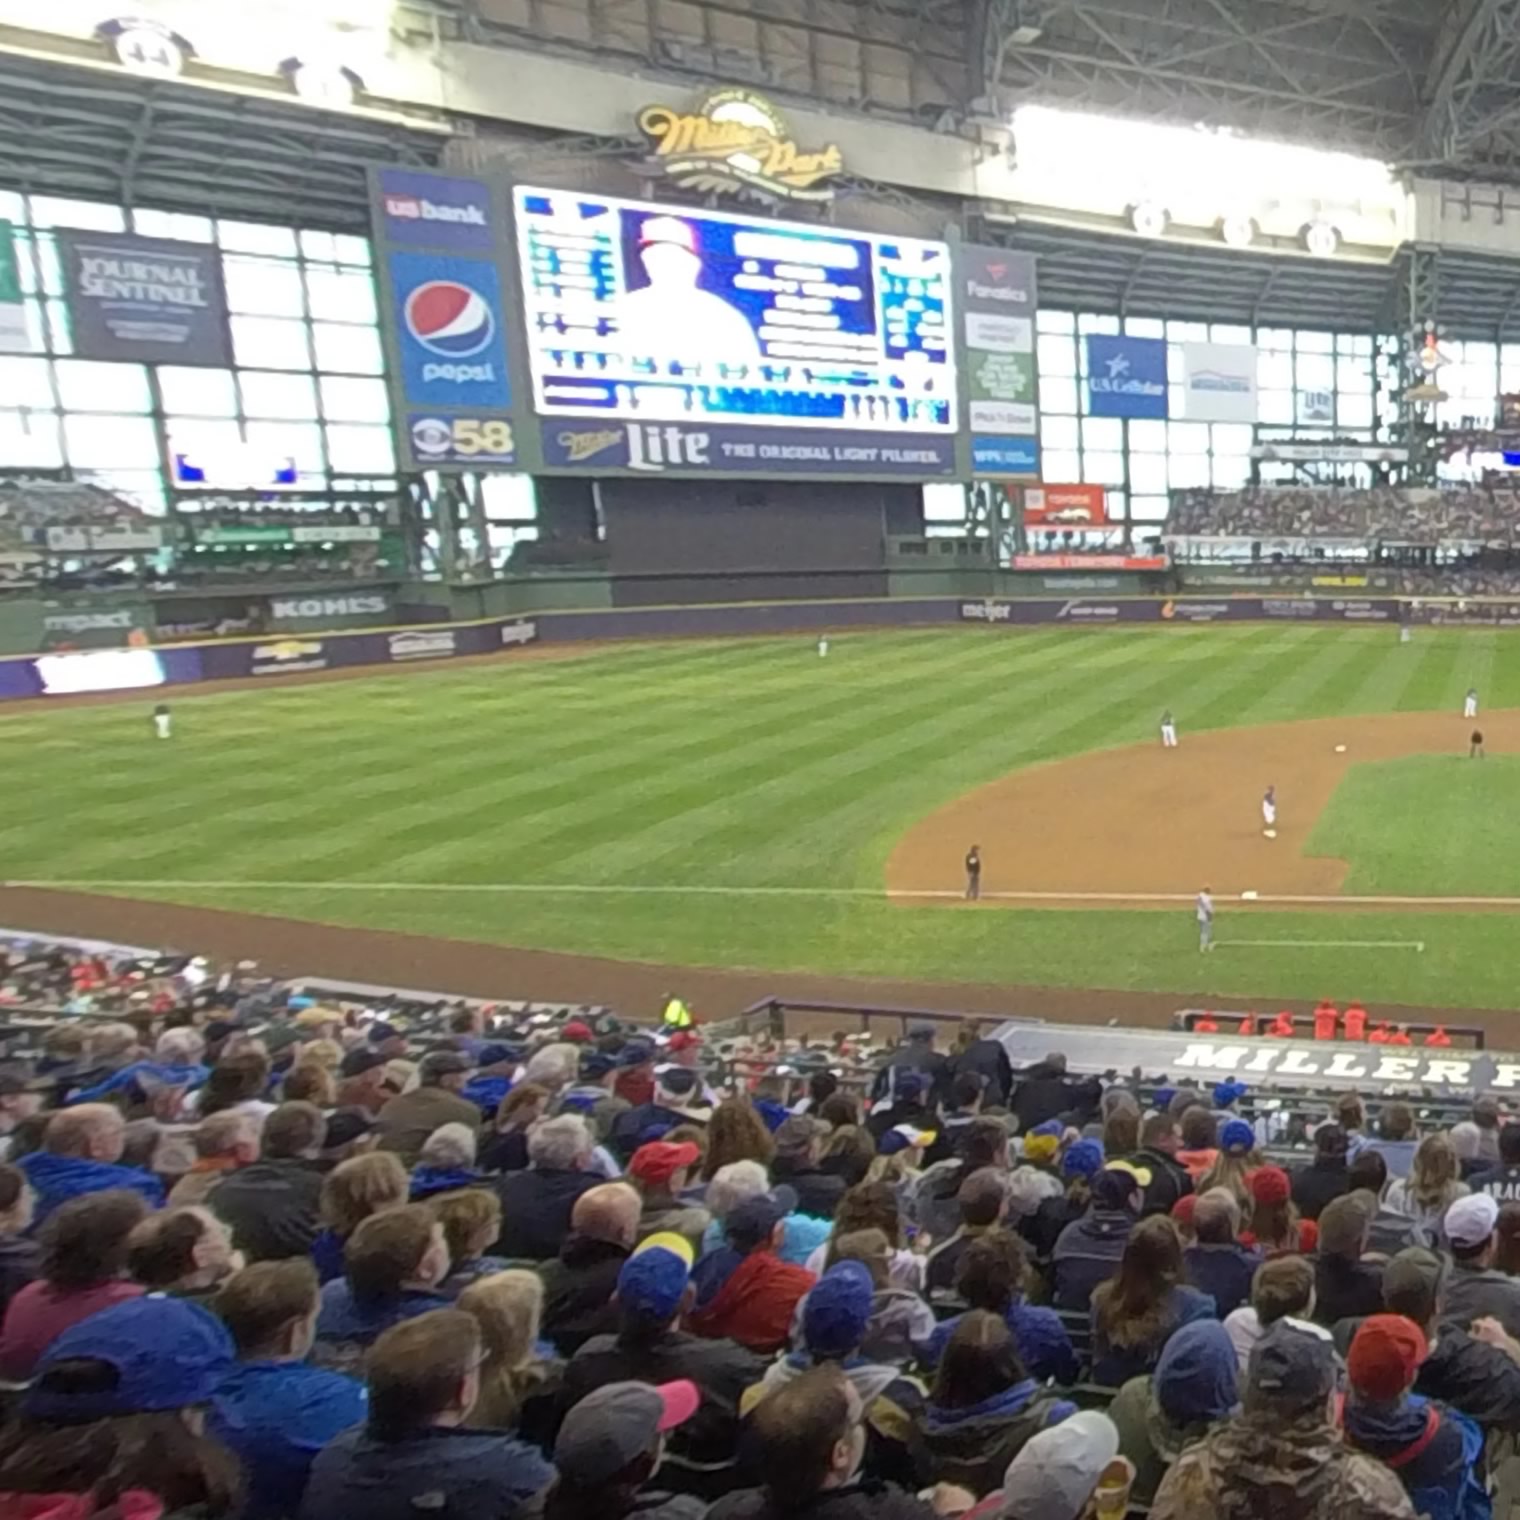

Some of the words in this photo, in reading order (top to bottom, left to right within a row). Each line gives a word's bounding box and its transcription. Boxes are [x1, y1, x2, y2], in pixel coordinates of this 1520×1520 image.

[762, 141, 842, 187] Park
[80, 257, 205, 287] JOURNAL
[80, 272, 208, 307] SENTINEL
[422, 363, 496, 382] pepsi
[453, 420, 513, 454] 58
[625, 423, 710, 471] Lite
[1174, 1044, 1471, 1083] MILLER
